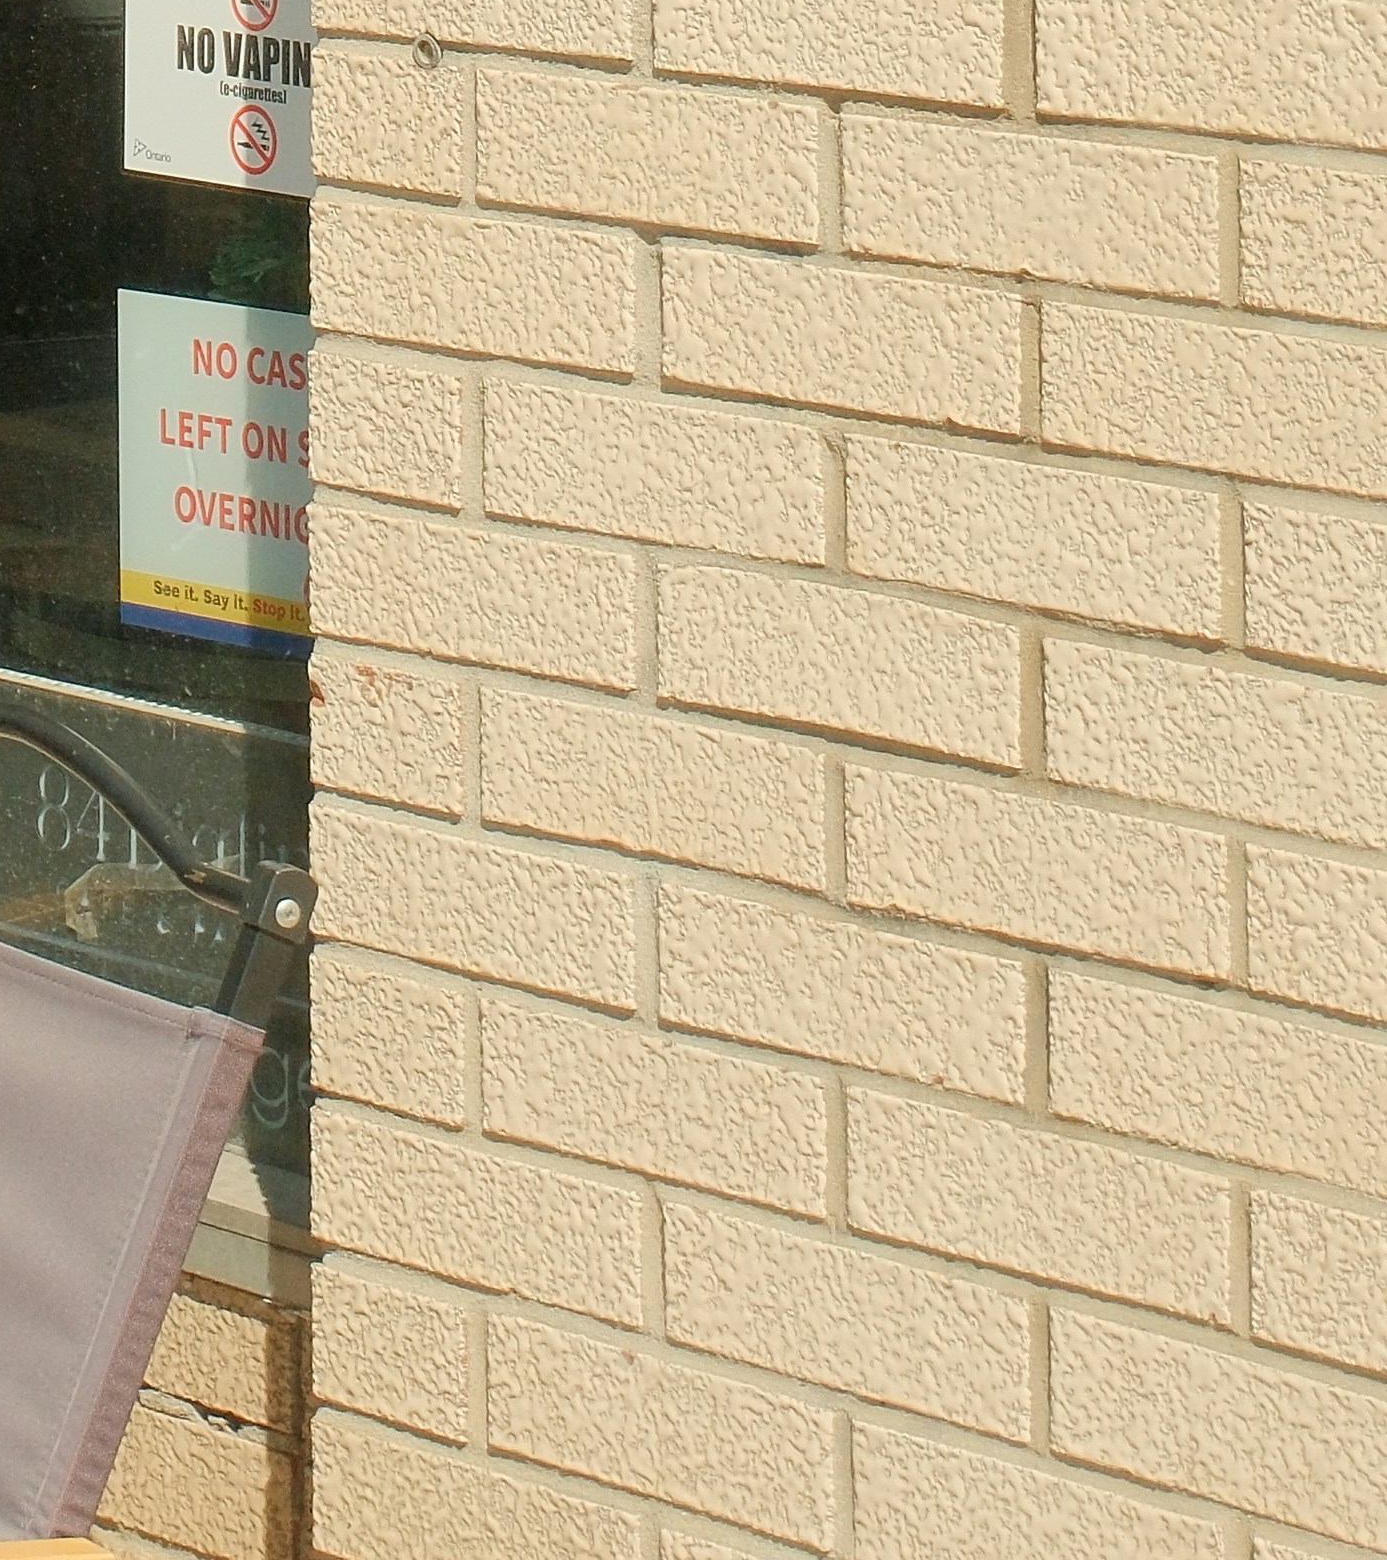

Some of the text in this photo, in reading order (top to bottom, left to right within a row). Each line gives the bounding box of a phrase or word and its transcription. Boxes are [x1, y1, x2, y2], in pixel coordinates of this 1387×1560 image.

[176, 24, 215, 75] NO
[145, 148, 172, 164] Ontario
[192, 338, 238, 380] NO
[159, 407, 233, 454] LEFT
[242, 421, 288, 464] ON
[153, 579, 180, 598] See
[203, 588, 229, 611] Say
[252, 597, 286, 621] Stop
